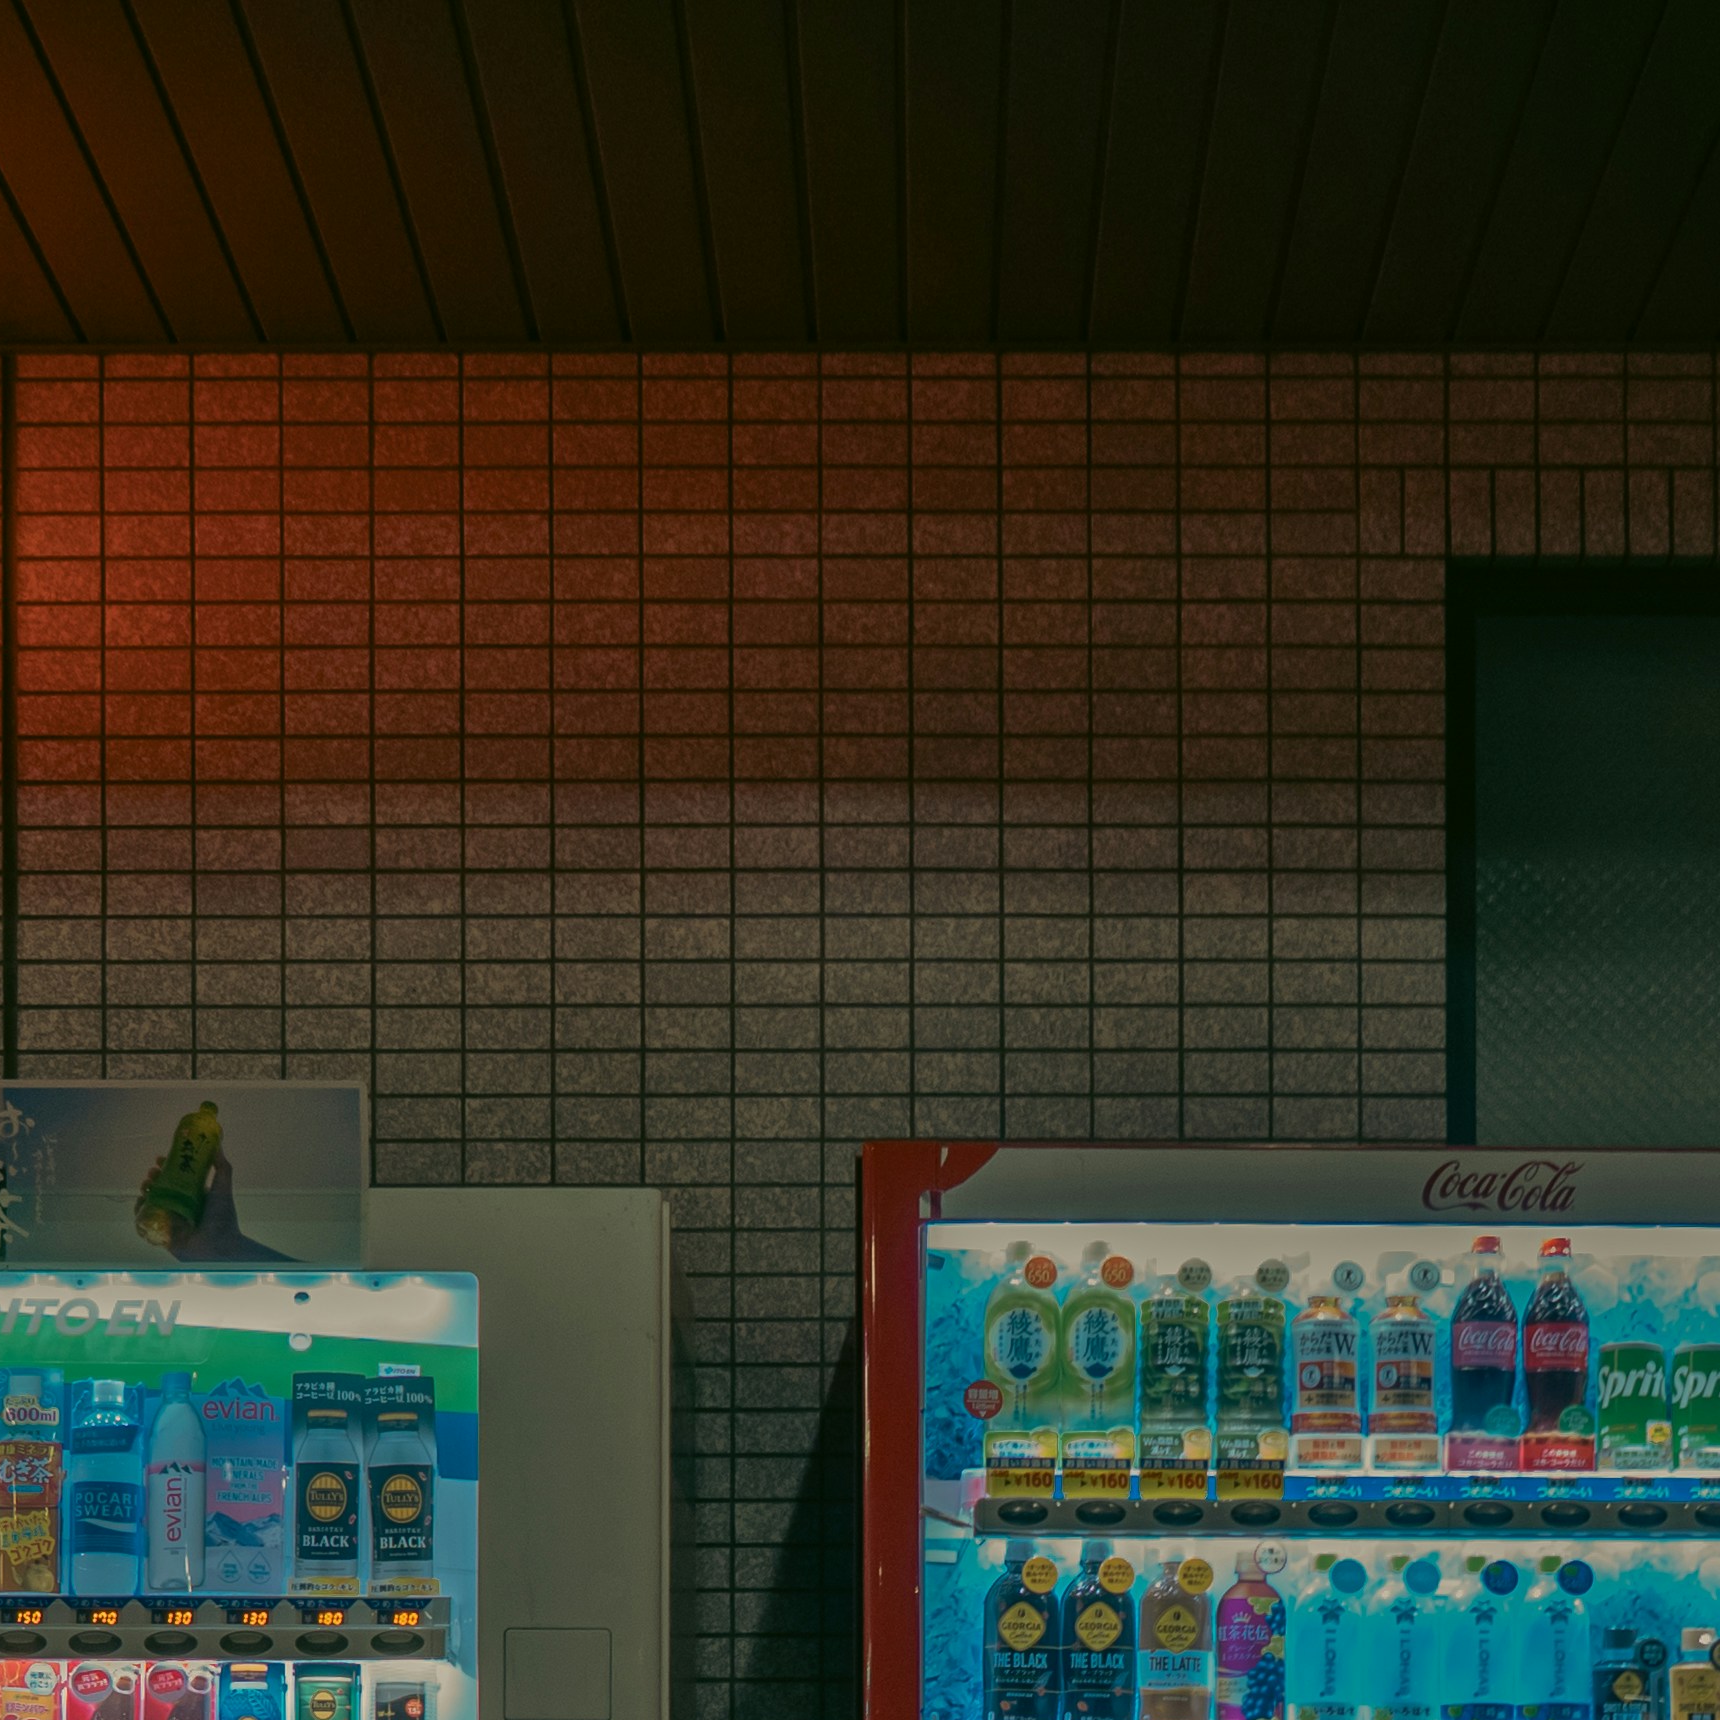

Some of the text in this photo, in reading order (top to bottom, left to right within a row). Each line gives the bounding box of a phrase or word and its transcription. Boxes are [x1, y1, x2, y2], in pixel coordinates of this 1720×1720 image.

[1422, 1160, 1586, 1211] Coca-Cola
[0, 1297, 182, 1336] ITO EN
[1007, 1309, 1034, 1363] 綾鷹
[1084, 1309, 1110, 1363] 綾鷹
[1334, 1332, 1355, 1355] W
[1458, 1326, 1516, 1352] Coca-Cola
[1598, 1360, 1665, 1409] Sprit
[336, 1390, 362, 1402] 100%
[5, 1406, 57, 1422] 600ml
[1014, 1471, 1053, 1488] ¥160
[1090, 1471, 1128, 1488] ¥160
[1167, 1471, 1206, 1489] ¥160
[75, 1491, 138, 1505] POCARI
[75, 1504, 133, 1518] SWEAT
[163, 1476, 182, 1543] evian
[302, 1534, 349, 1548] BLACK
[380, 1536, 426, 1549] BLACK
[10, 1538, 53, 1563] ゴクゴク
[17, 1610, 42, 1624] 150
[92, 1611, 118, 1625] 170
[167, 1611, 192, 1625] 130
[243, 1611, 268, 1625] 130
[318, 1612, 343, 1625] 180
[393, 1612, 419, 1625] 180
[1000, 1622, 1042, 1631] GEORGIA
[1077, 1622, 1119, 1631] GEORGIA
[993, 1652, 1048, 1669] THE BLACK
[1070, 1652, 1125, 1669] THE BLACK
[1148, 1655, 1201, 1672] THE LATTE
